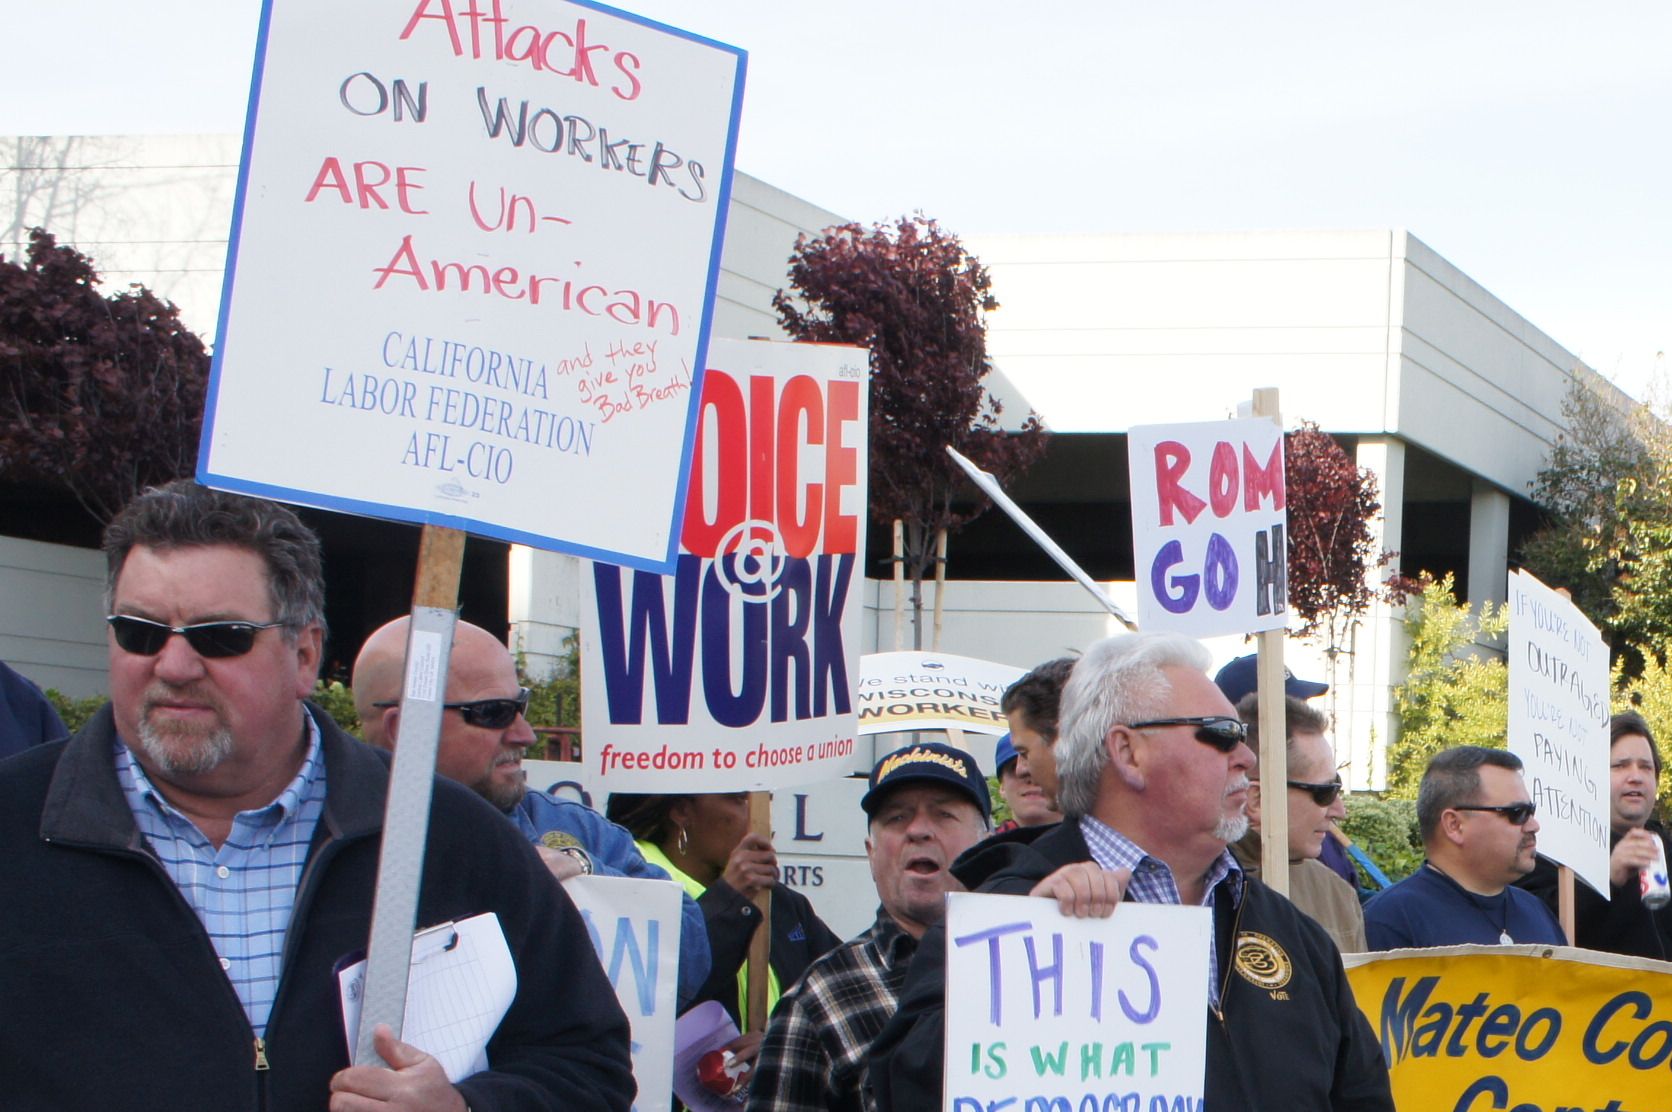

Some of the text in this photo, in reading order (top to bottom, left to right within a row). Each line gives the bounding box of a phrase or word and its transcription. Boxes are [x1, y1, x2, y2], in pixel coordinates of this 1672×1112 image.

[400, 0, 642, 101] Attacks
[339, 72, 708, 203] ON WORKERS
[304, 156, 429, 215] ARE
[373, 235, 681, 335] American
[382, 331, 550, 400] CALIFORNIA
[556, 340, 658, 376] and they
[577, 358, 658, 404] give you
[320, 368, 596, 457] LABOR FEDERATION
[592, 388, 634, 424] Bad
[401, 431, 513, 484] AFL-CIO
[1154, 437, 1286, 527] ROM
[1151, 524, 1286, 617] GO H
[593, 553, 856, 728] WORK
[1515, 590, 1592, 663] IF YOU'RE NOT
[894, 673, 968, 687] stand
[1528, 641, 1610, 729] OUTRAGED
[1524, 688, 1589, 745] YOU'RE NOT
[600, 734, 853, 775] freedom to choose a union
[1533, 733, 1598, 801] PAYING
[1532, 777, 1607, 849] ATTENTION
[954, 920, 1162, 1027] THIS
[1380, 976, 1563, 1068] Mateo
[970, 1040, 1172, 1080] IS WHAT
